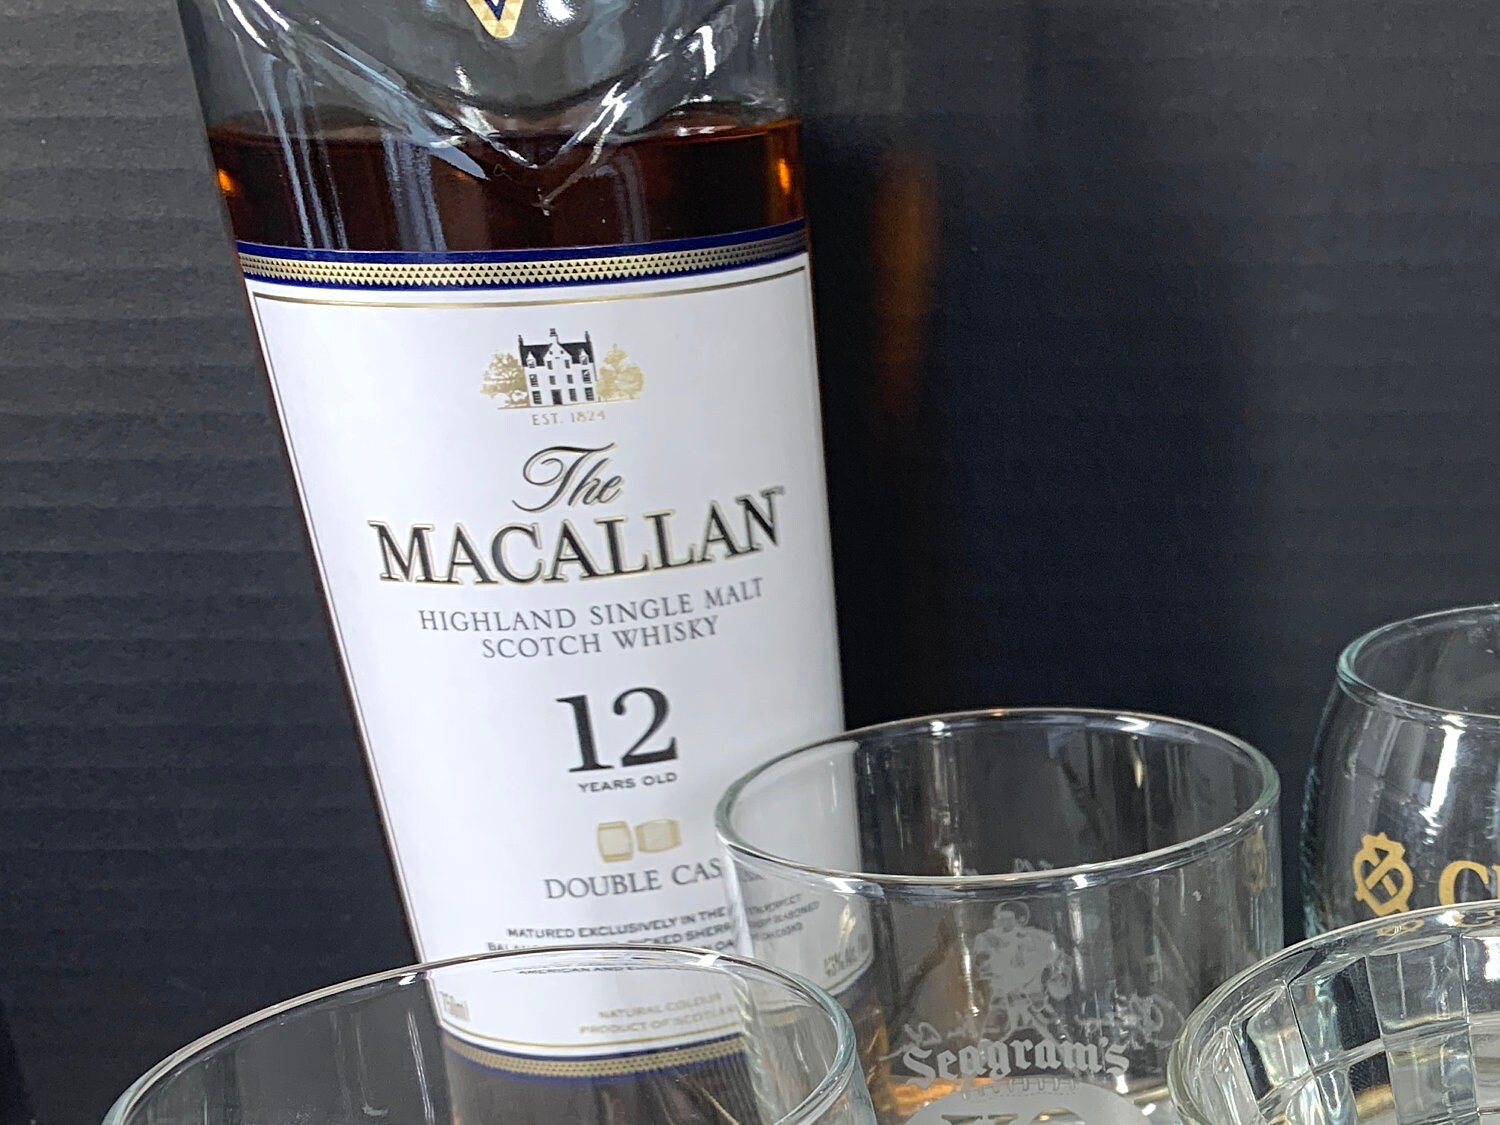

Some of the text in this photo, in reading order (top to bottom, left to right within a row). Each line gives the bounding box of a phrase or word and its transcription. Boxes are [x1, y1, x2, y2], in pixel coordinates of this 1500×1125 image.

[531, 408, 607, 426] EST. 1824
[513, 442, 623, 513] The
[368, 486, 786, 586] MACALLAN
[419, 577, 764, 633] HIGHLAND SINGLE MALT
[481, 615, 720, 659] SCOTCH WHISKY
[555, 686, 679, 774] 12
[578, 771, 678, 794] YEARS OLD
[544, 857, 723, 900] DOUBLE CAS
[506, 927, 576, 940] MATURED
[578, 917, 678, 938] EXCLUSIVELY
[681, 913, 696, 926] IN
[698, 906, 727, 922] THE
[578, 1021, 647, 1035] PRODUCT
[903, 1037, 1130, 1090] Seagram's
